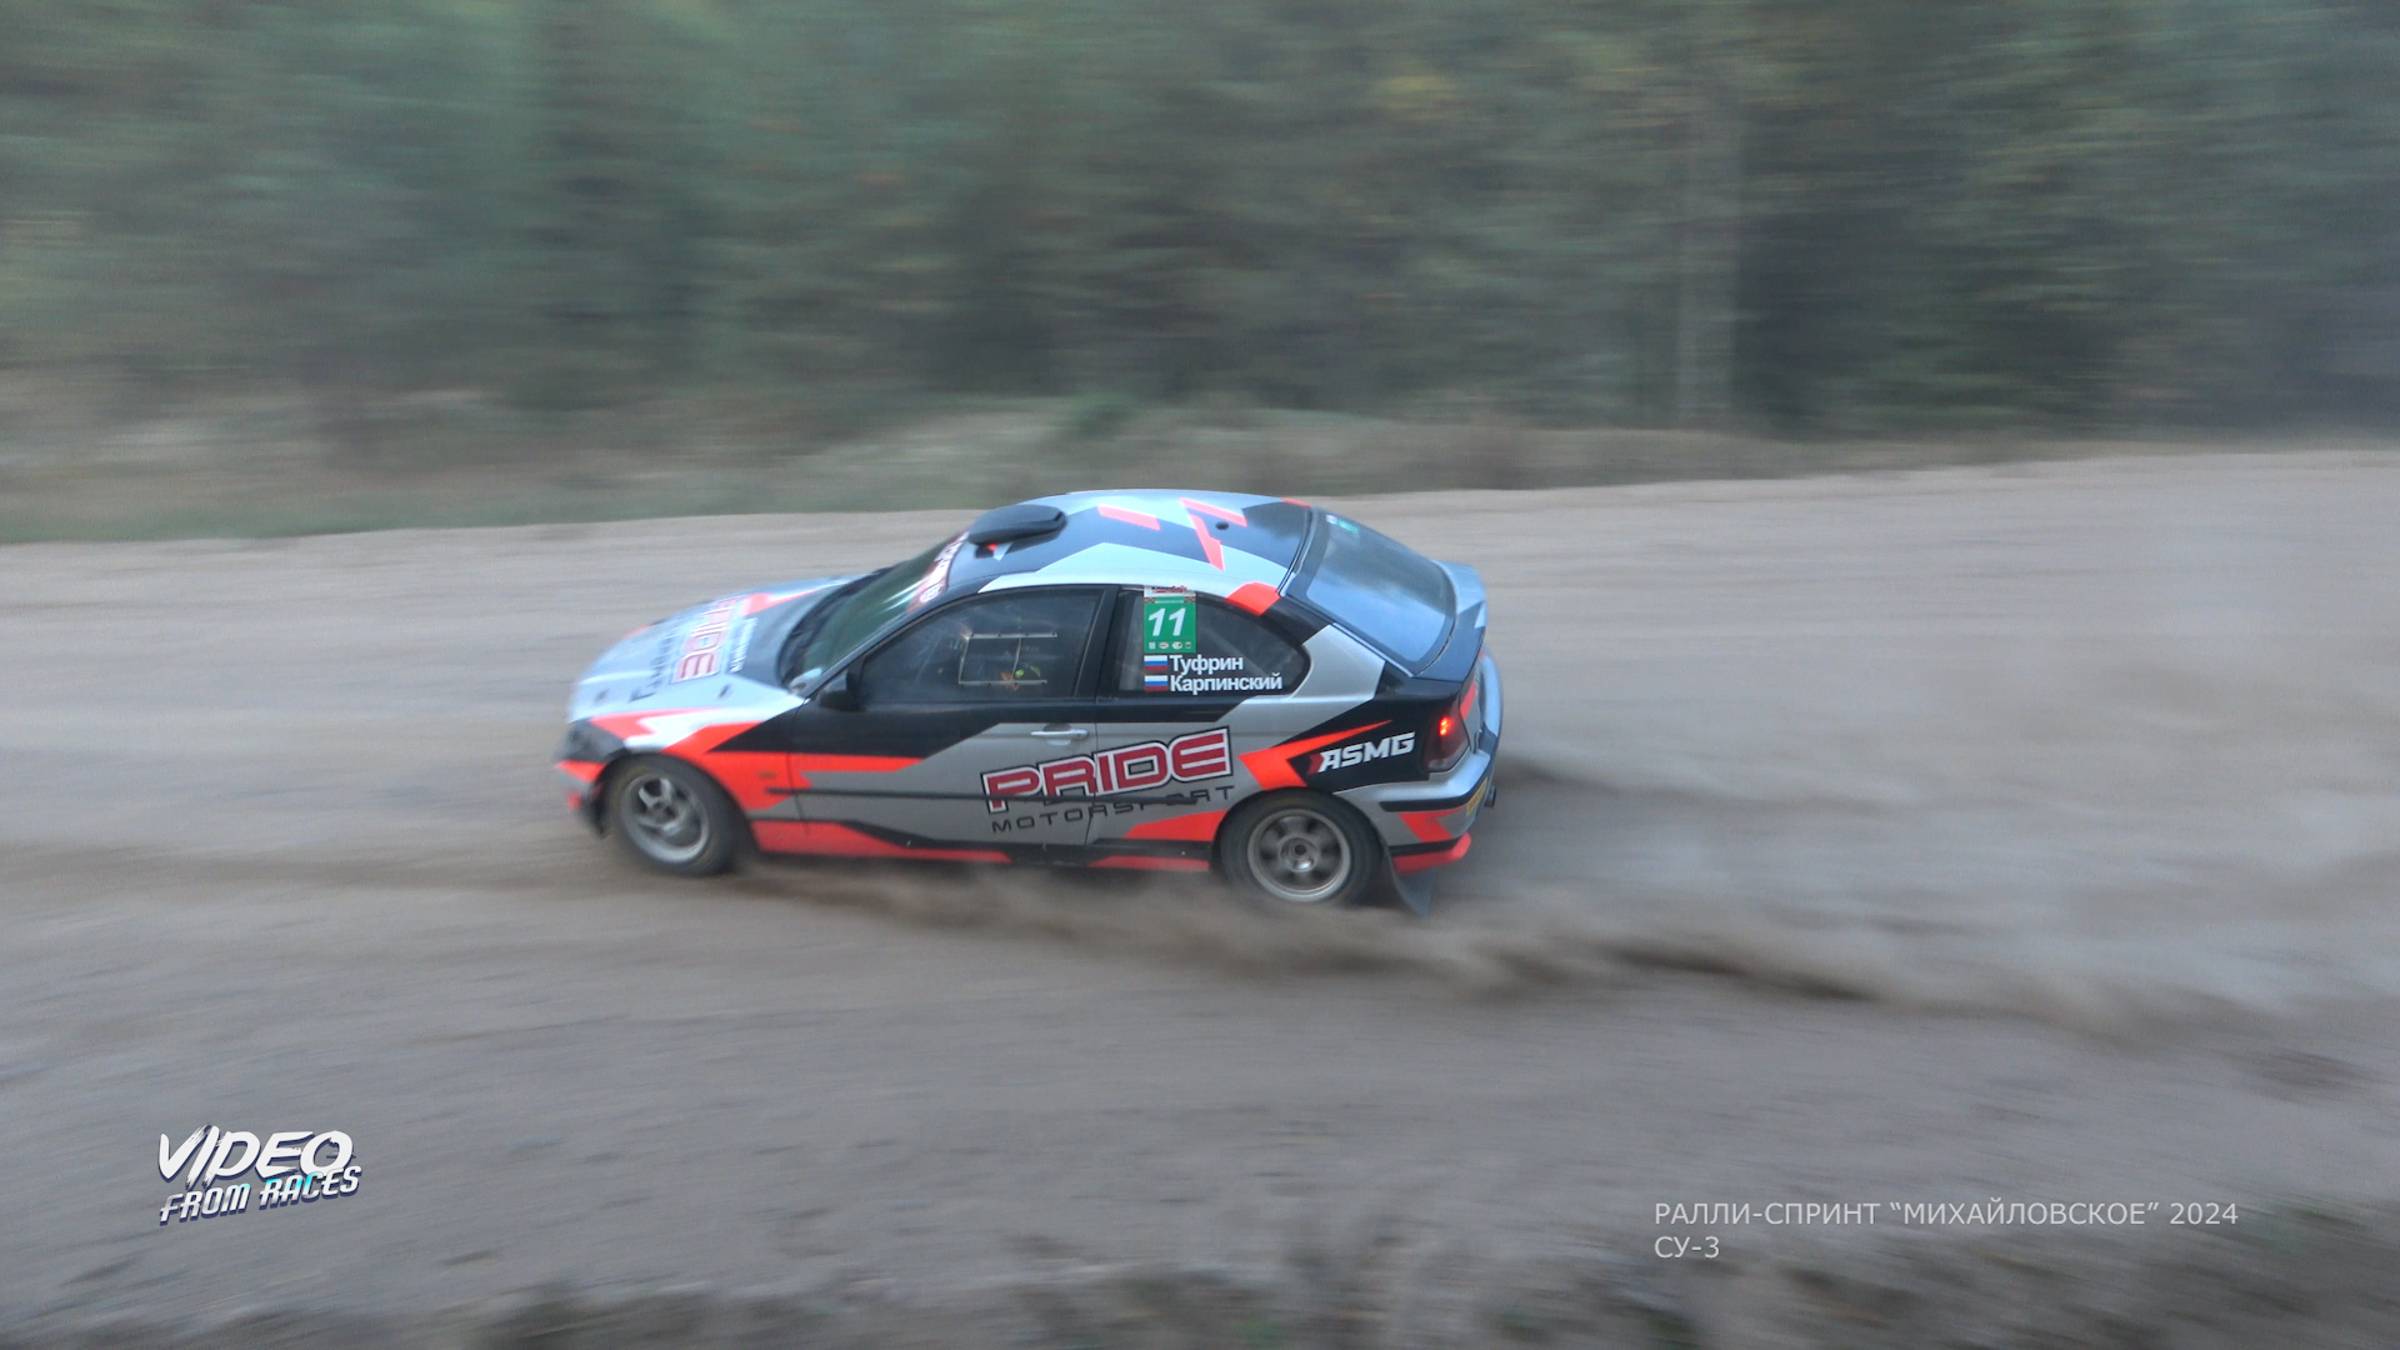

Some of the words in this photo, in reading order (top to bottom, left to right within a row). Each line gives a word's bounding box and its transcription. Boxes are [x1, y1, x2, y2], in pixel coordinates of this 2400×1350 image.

[1147, 608, 1186, 637] 11
[1169, 654, 1244, 675] Туфрин
[1169, 673, 1283, 695] Карпинский
[1317, 732, 1415, 773] ASMG
[980, 725, 1234, 815] PRIDE
